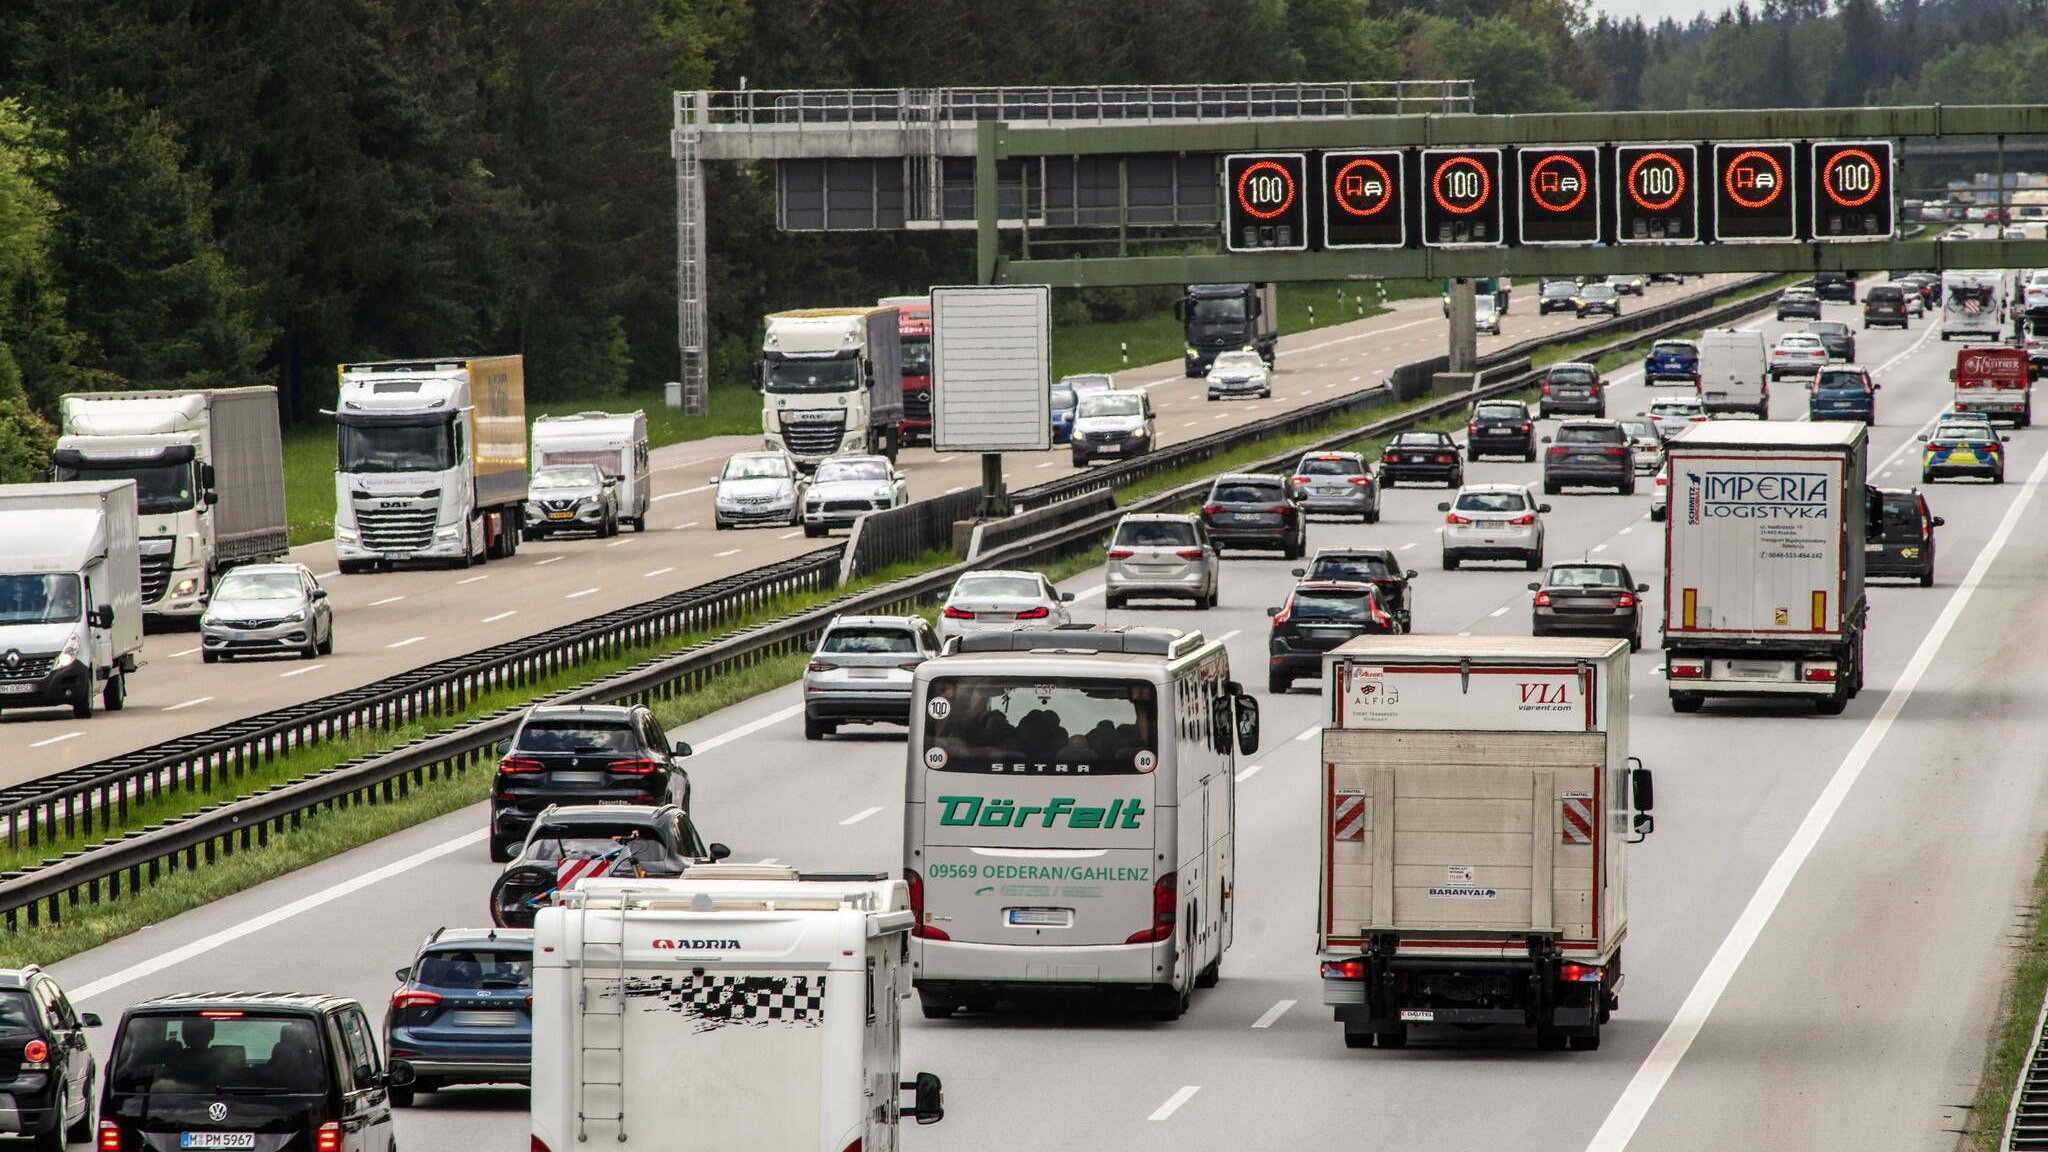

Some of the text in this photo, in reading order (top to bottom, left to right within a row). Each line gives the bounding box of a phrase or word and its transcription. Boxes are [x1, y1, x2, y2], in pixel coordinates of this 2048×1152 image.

[1445, 171, 1477, 198] 100
[1640, 167, 1673, 195] 100
[1835, 164, 1869, 191] 100
[1249, 176, 1282, 203] 100
[1688, 486, 1696, 525] SCHMITZ
[1704, 505, 1828, 519] LOGISTYKA
[1516, 683, 1572, 703] VIA
[1355, 697, 1395, 705] ALFIO
[931, 702, 947, 715] 100
[929, 753, 943, 763] 100
[1140, 757, 1151, 765] 80
[991, 763, 1090, 773] SETRA
[937, 795, 1145, 829] Dörfelt
[929, 864, 1149, 882] 09569 OEDERAN/GAHLENZ
[1429, 888, 1484, 896] BARANYAI
[678, 939, 741, 949] ADRIA
[190, 1134, 253, 1146] M PM 5967
